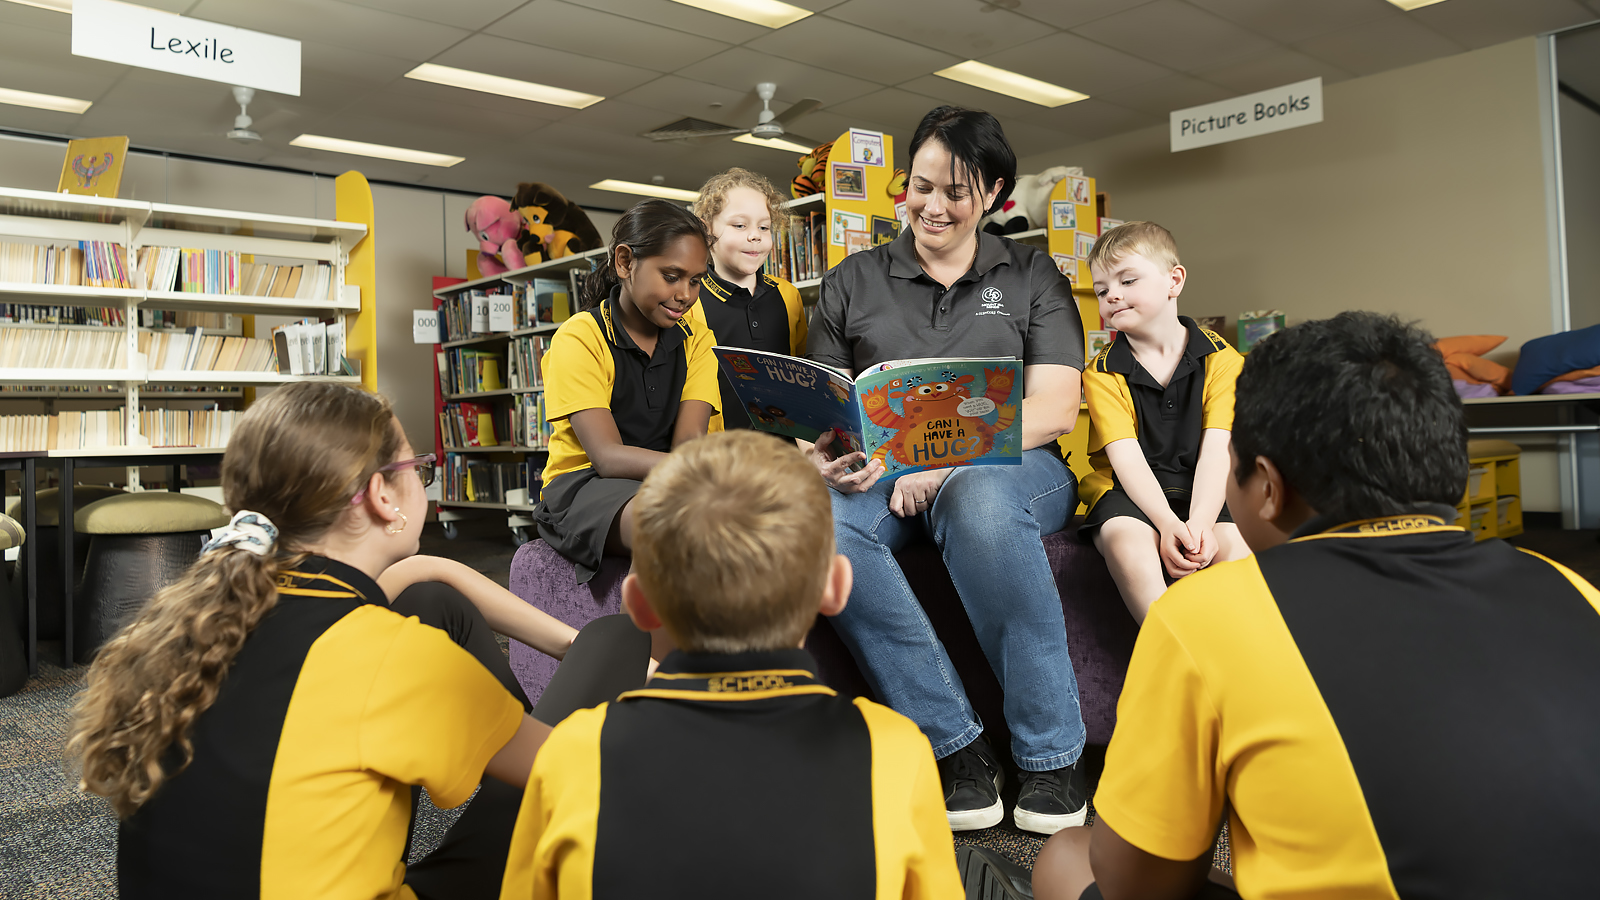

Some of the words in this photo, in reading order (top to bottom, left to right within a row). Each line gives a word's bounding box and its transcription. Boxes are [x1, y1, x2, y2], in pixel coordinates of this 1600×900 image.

[151, 26, 235, 64] Lexile
[1181, 111, 1248, 137] Picture
[1253, 94, 1311, 122] Books
[476, 305, 489, 317] 10
[493, 303, 511, 313] 200
[418, 317, 437, 328] 000
[756, 356, 778, 367] CAN
[778, 360, 783, 368] I
[784, 361, 809, 375] HAVE
[810, 369, 818, 379] A
[765, 364, 817, 391] HUG?
[926, 418, 952, 430] CAN
[956, 418, 960, 428] I
[923, 429, 953, 442] HAVE
[957, 428, 966, 438] A
[912, 435, 981, 463] HUG?
[1358, 517, 1437, 533] SCHOOL
[707, 675, 794, 693] SCHOOL
